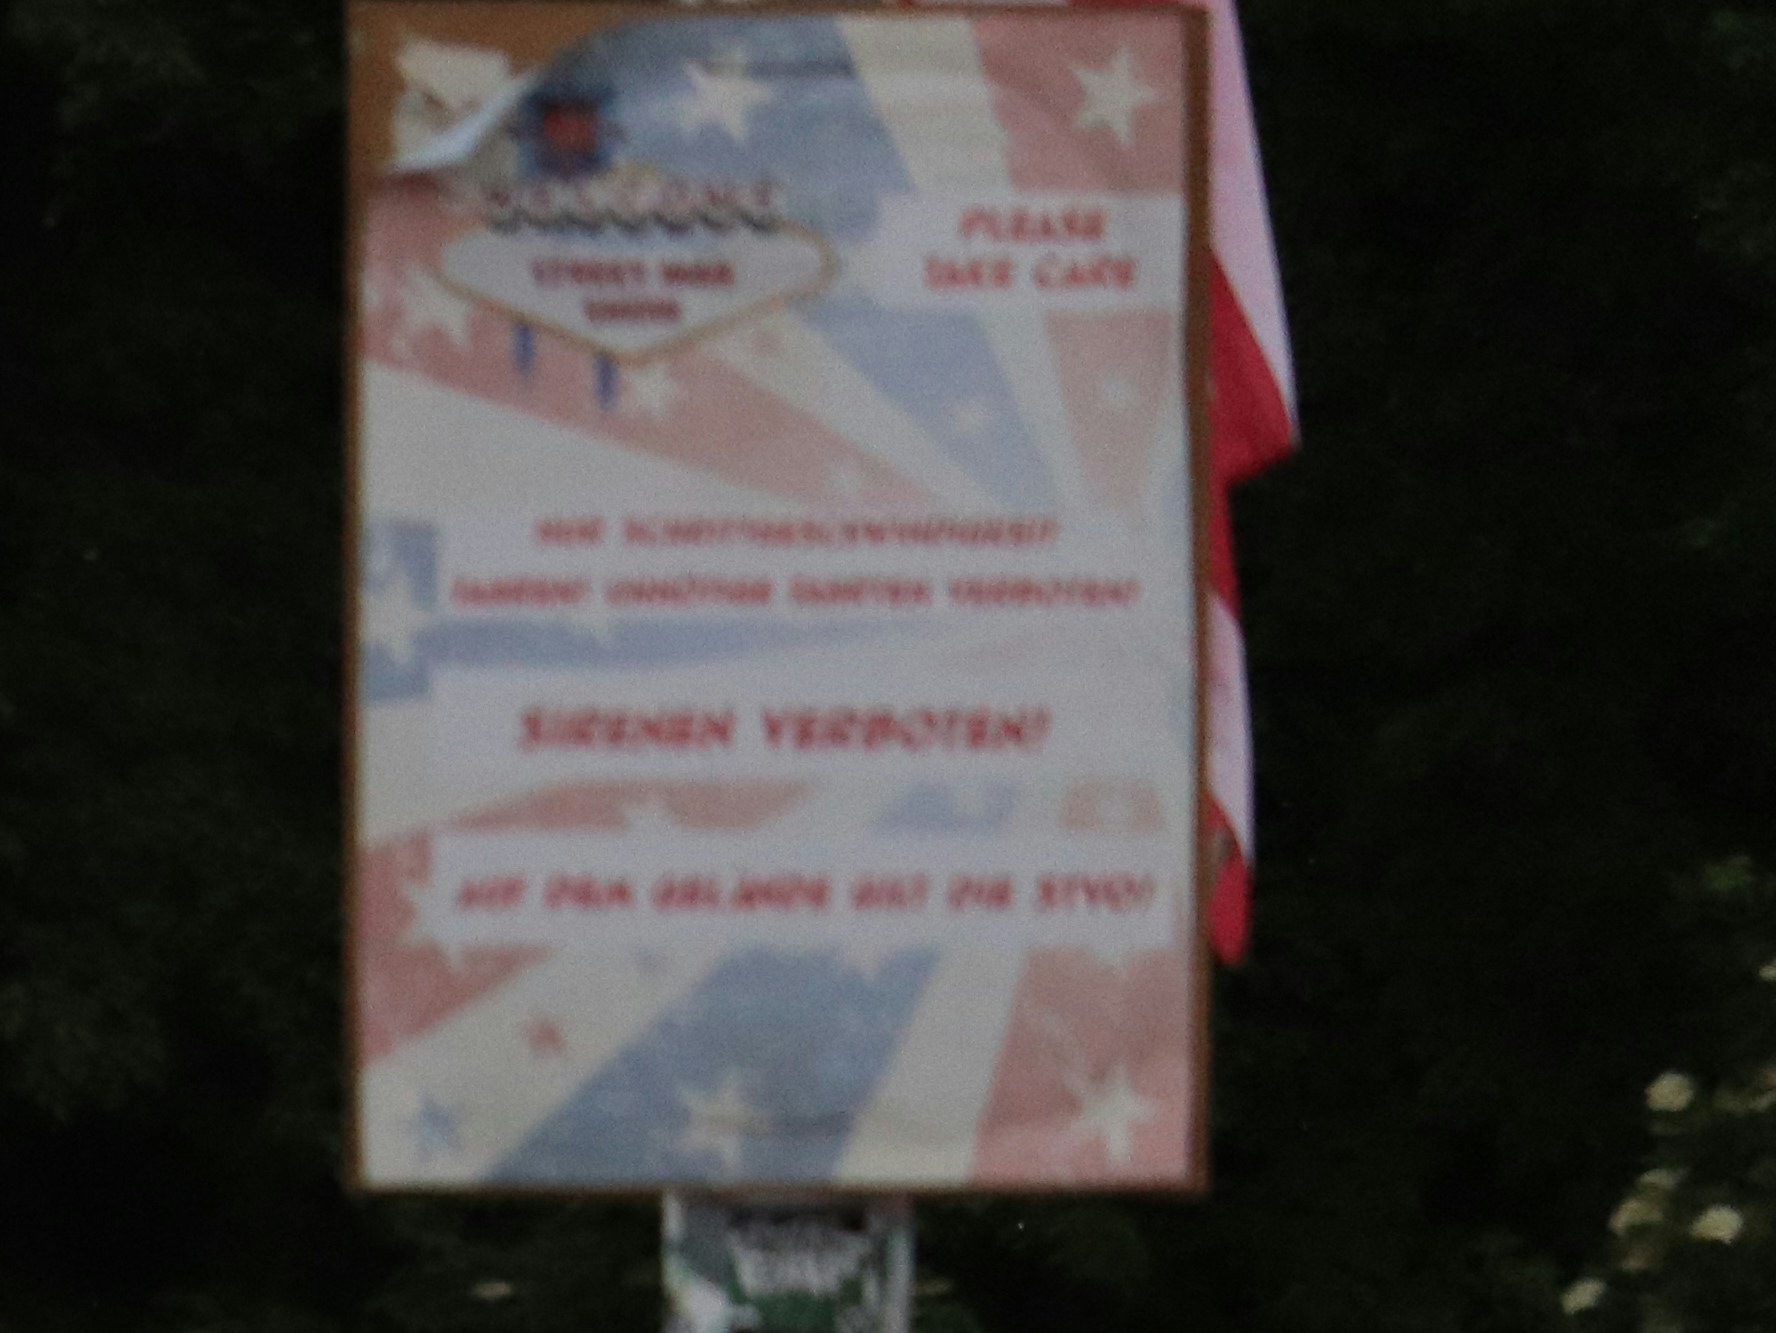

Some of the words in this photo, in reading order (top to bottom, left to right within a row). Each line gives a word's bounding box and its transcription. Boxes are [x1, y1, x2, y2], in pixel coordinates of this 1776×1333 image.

[958, 207, 1108, 242] PLEASE
[1034, 255, 1138, 290] CARE
[521, 708, 737, 750] SIRENEN
[762, 707, 1052, 750] VERBOTEN!
